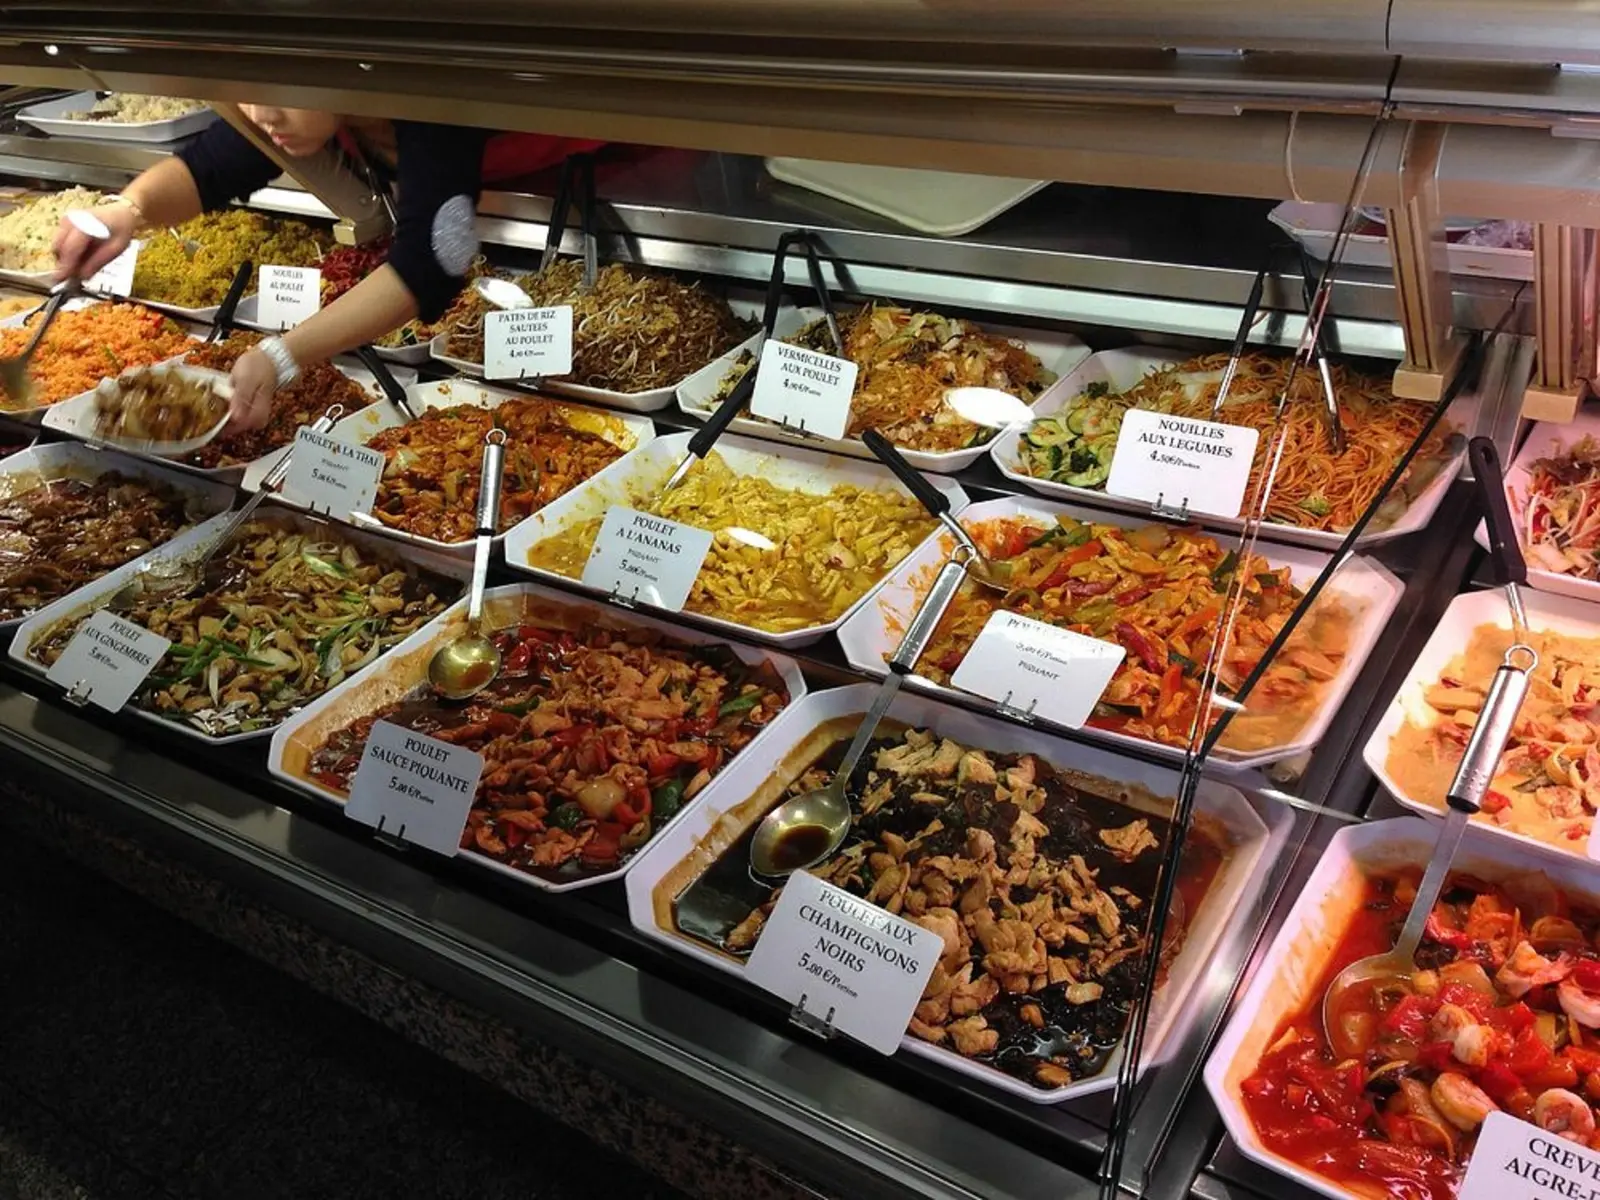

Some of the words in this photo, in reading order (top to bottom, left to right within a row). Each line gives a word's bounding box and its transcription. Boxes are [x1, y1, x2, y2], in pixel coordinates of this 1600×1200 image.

[541, 310, 556, 320] RIZ
[505, 336, 519, 345] AU
[520, 334, 553, 345] POULET
[778, 346, 842, 373] VERMICELLES
[780, 362, 802, 376] AUX
[803, 367, 840, 387] POULET
[1158, 419, 1225, 440] NOUILLES
[300, 430, 335, 450] POULET
[342, 446, 355, 459] LA
[356, 450, 379, 468] THAI
[1138, 432, 1167, 446] AUX
[1169, 436, 1233, 459] LEGUMES
[632, 515, 677, 537] POULET
[616, 527, 626, 538] A
[626, 529, 682, 555] L'ANANAS
[109, 620, 142, 642] POULET
[404, 737, 451, 763] POULET
[370, 745, 410, 769] SAUCE
[408, 759, 470, 795] PIQUANTE
[819, 889, 879, 928] POULET
[879, 922, 918, 947] AUX
[799, 904, 920, 975] CHAMPIGNONS
[814, 936, 867, 974] NOIRS
